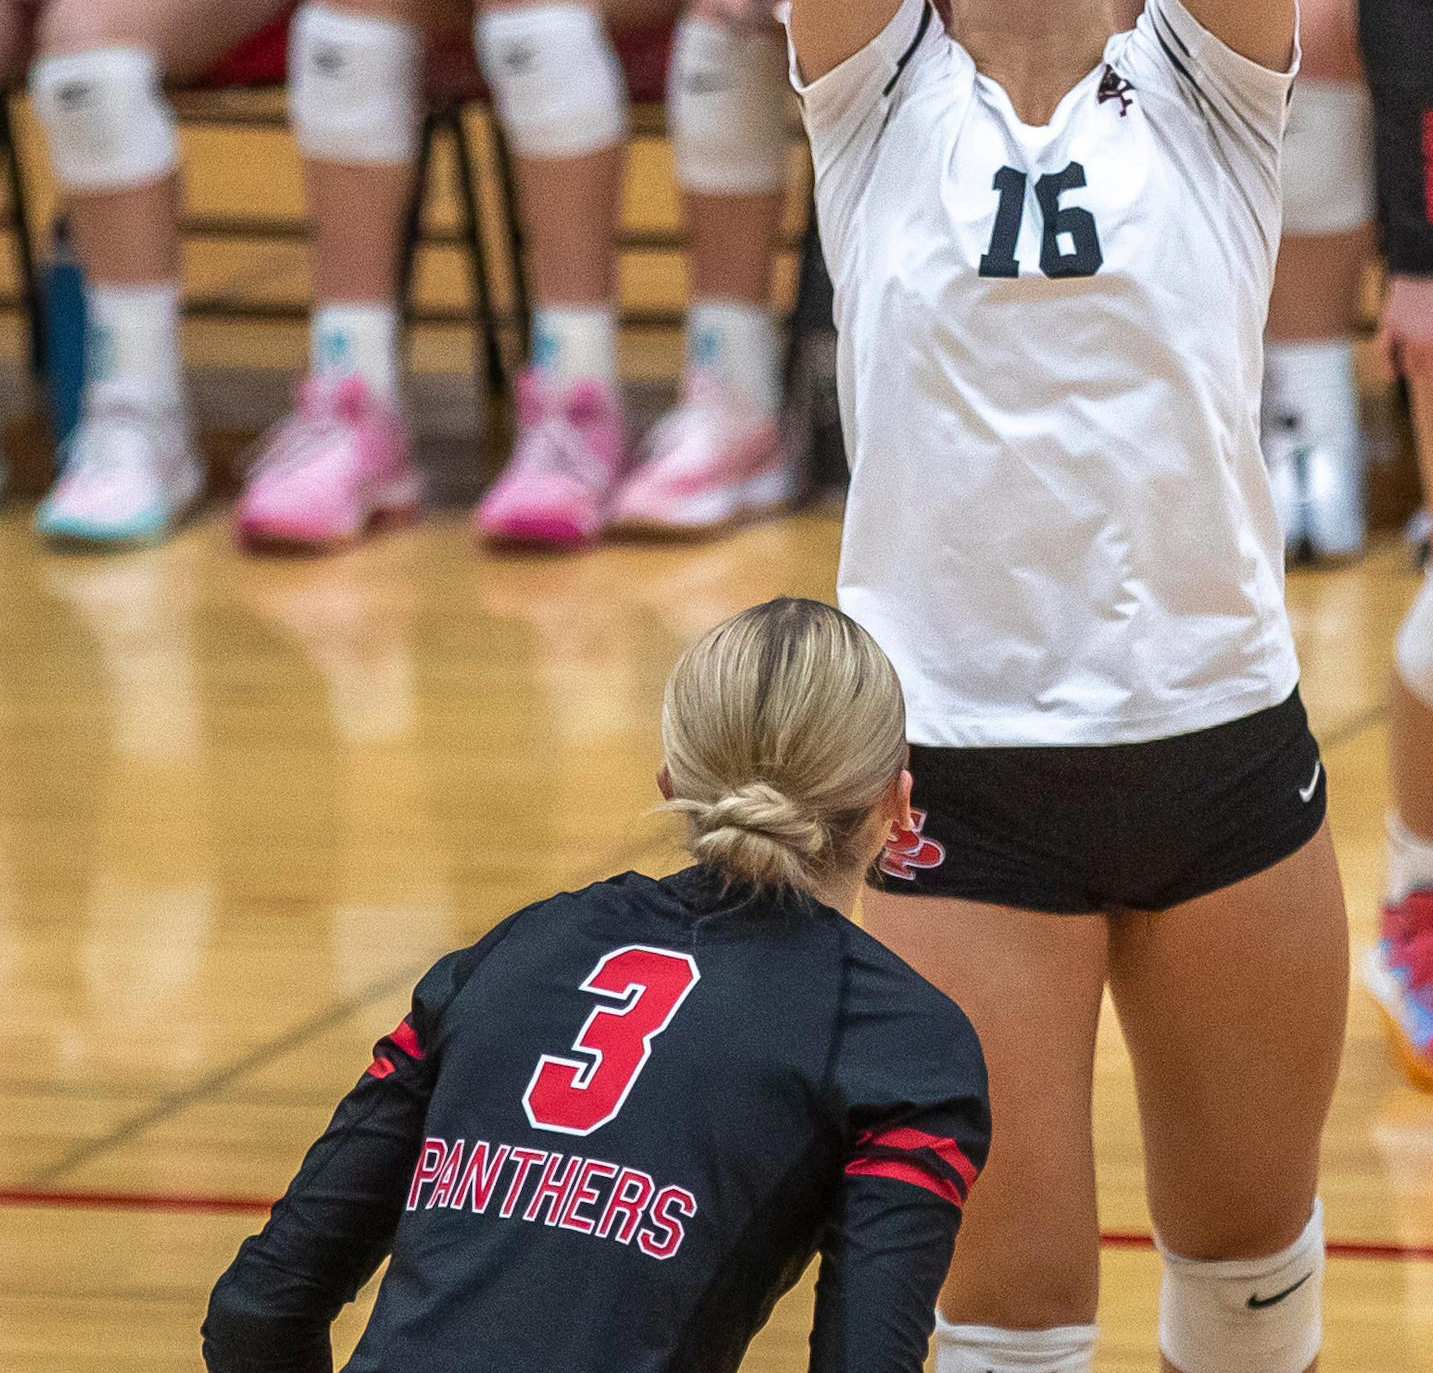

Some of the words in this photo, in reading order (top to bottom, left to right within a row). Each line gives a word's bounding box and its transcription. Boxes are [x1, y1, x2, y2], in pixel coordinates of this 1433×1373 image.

[979, 161, 1103, 279] 16
[522, 945, 700, 1135] 3
[406, 1138, 697, 1259] PANTHERS
